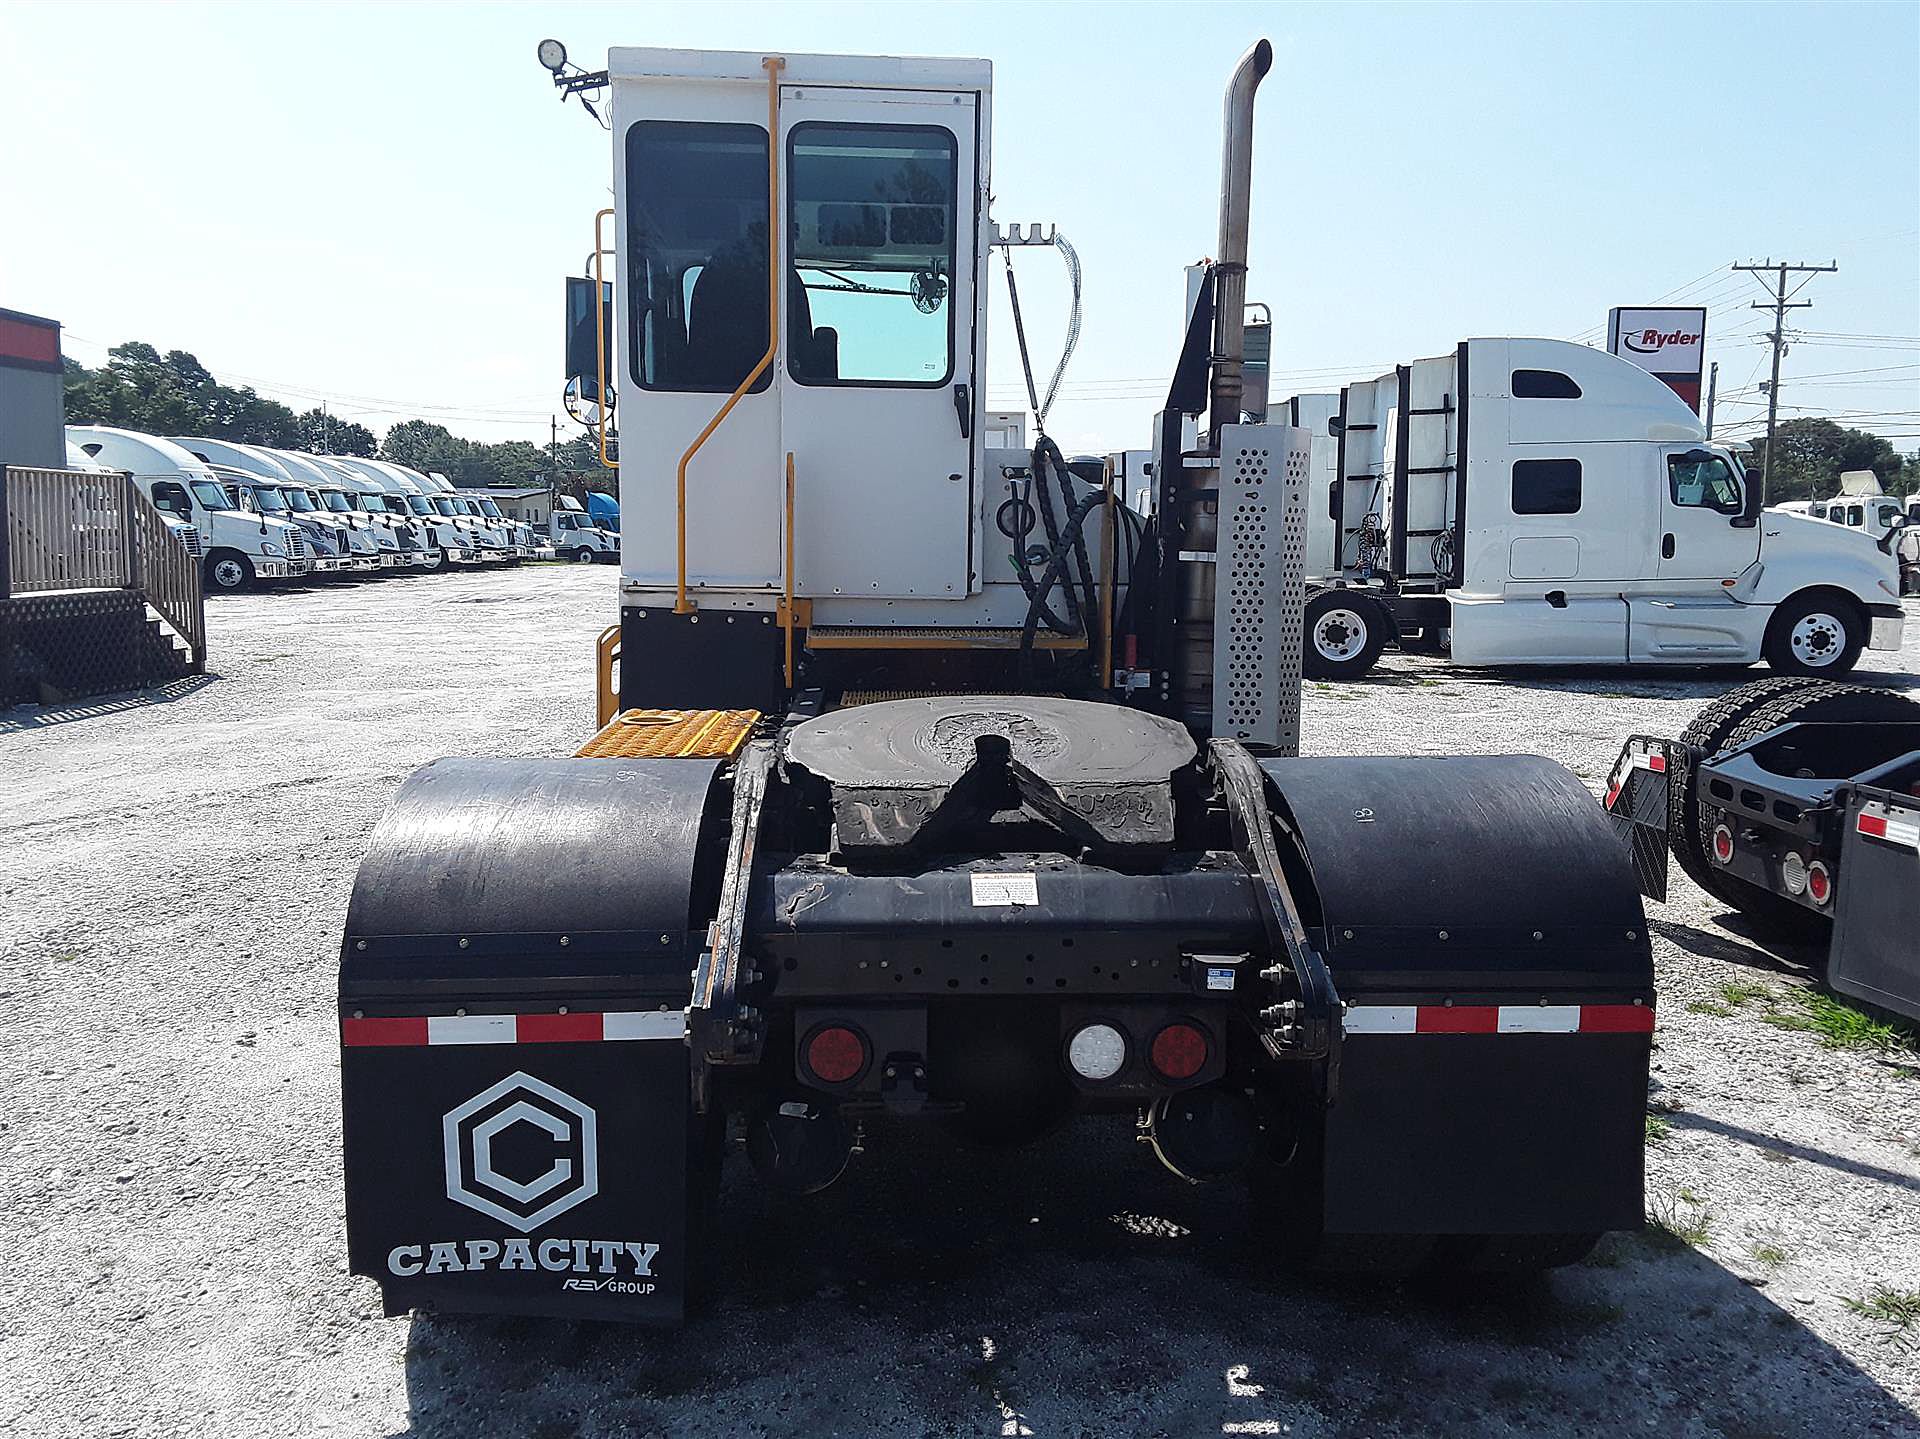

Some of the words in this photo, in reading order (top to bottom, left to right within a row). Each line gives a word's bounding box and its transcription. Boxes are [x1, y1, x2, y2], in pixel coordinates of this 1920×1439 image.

[1641, 329, 1701, 348] Ryder
[387, 1238, 660, 1277] CAPACITY
[562, 1276, 615, 1291] REV
[608, 1281, 656, 1295] GROUP
